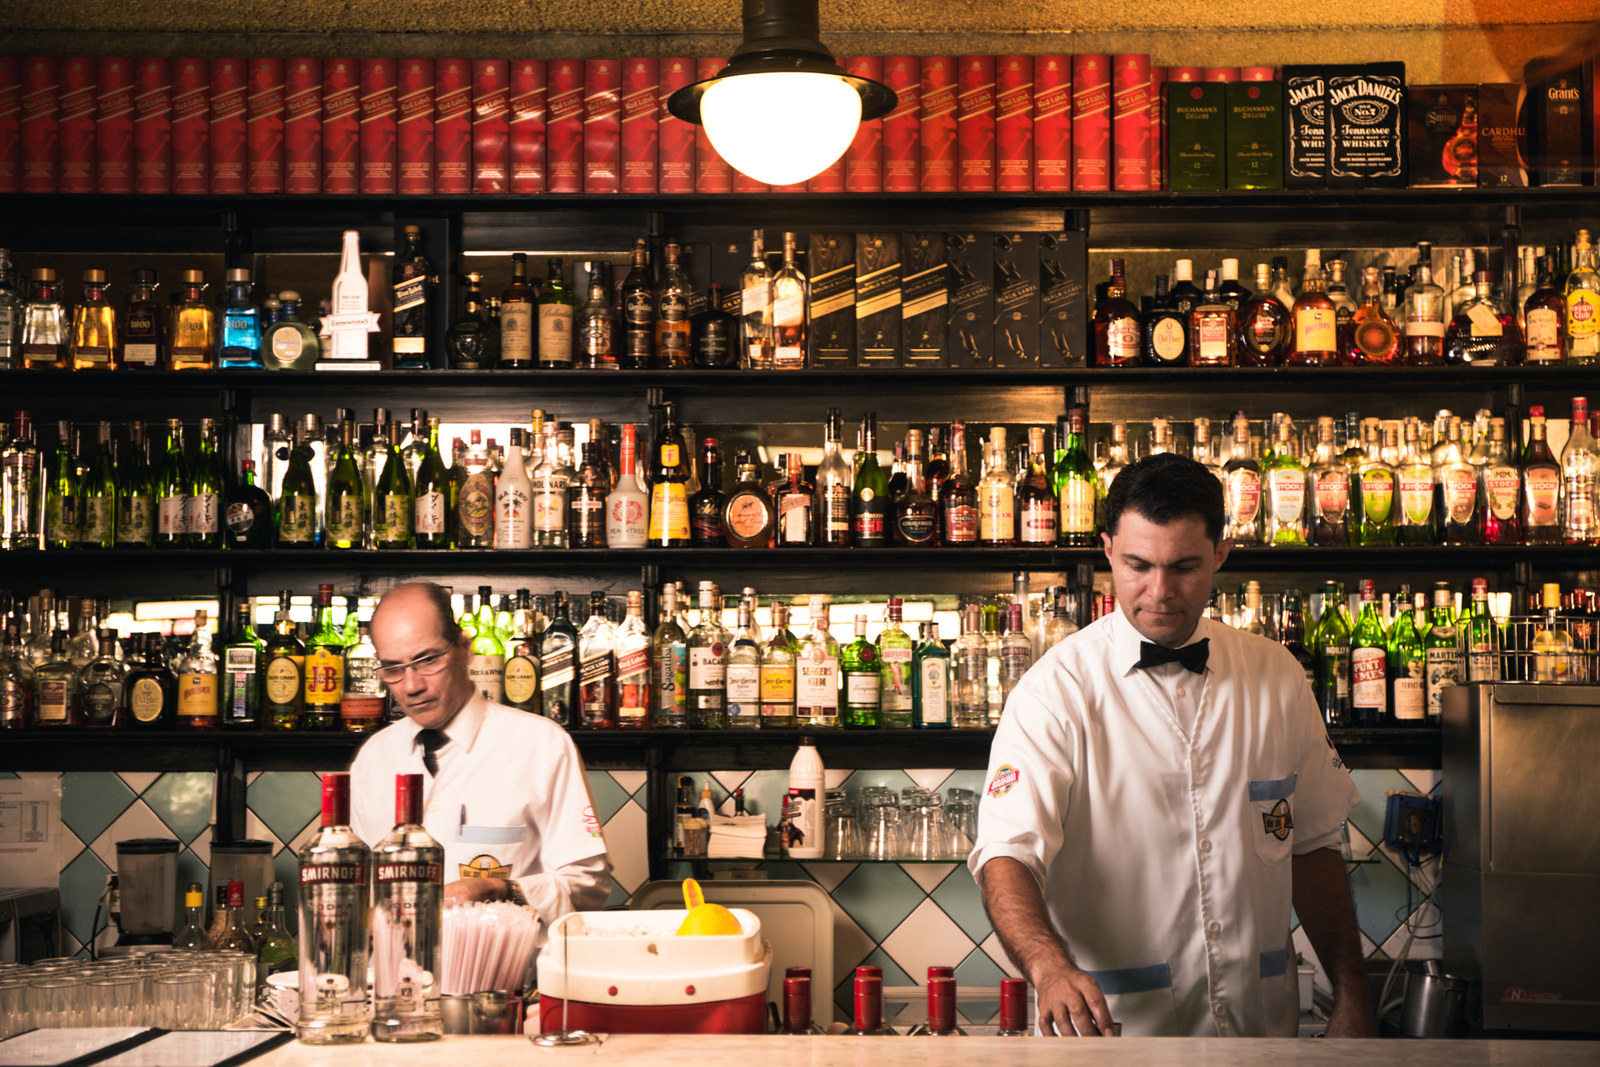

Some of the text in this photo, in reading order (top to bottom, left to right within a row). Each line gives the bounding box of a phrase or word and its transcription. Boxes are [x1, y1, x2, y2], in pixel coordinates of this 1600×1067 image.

[1117, 91, 1147, 107] Red Label
[1289, 84, 1318, 106] JACK
[1329, 84, 1359, 106] JACK
[1357, 79, 1403, 106] DANIEL'S
[1548, 87, 1580, 100] Grant's
[999, 92, 1029, 108] Red Label
[1037, 92, 1067, 108] Red Label
[1076, 92, 1106, 107] Red Label
[1341, 124, 1391, 136] Tennessee
[1301, 140, 1325, 149] WHIS
[1342, 140, 1390, 149] WHISKEY
[1574, 310, 1591, 319] Club
[130, 320, 151, 329] 1800
[498, 490, 528, 502] MAIBU
[629, 654, 647, 666] Label
[1429, 651, 1458, 659] MARTI
[662, 648, 675, 692] Sagatiba
[802, 666, 833, 676] SEAGERS
[1354, 660, 1380, 673] PUNT
[1359, 668, 1385, 682] MES
[808, 678, 827, 687] GIN
[302, 865, 362, 882] SMIRNOFF
[378, 865, 438, 881] SMIRNOFF
